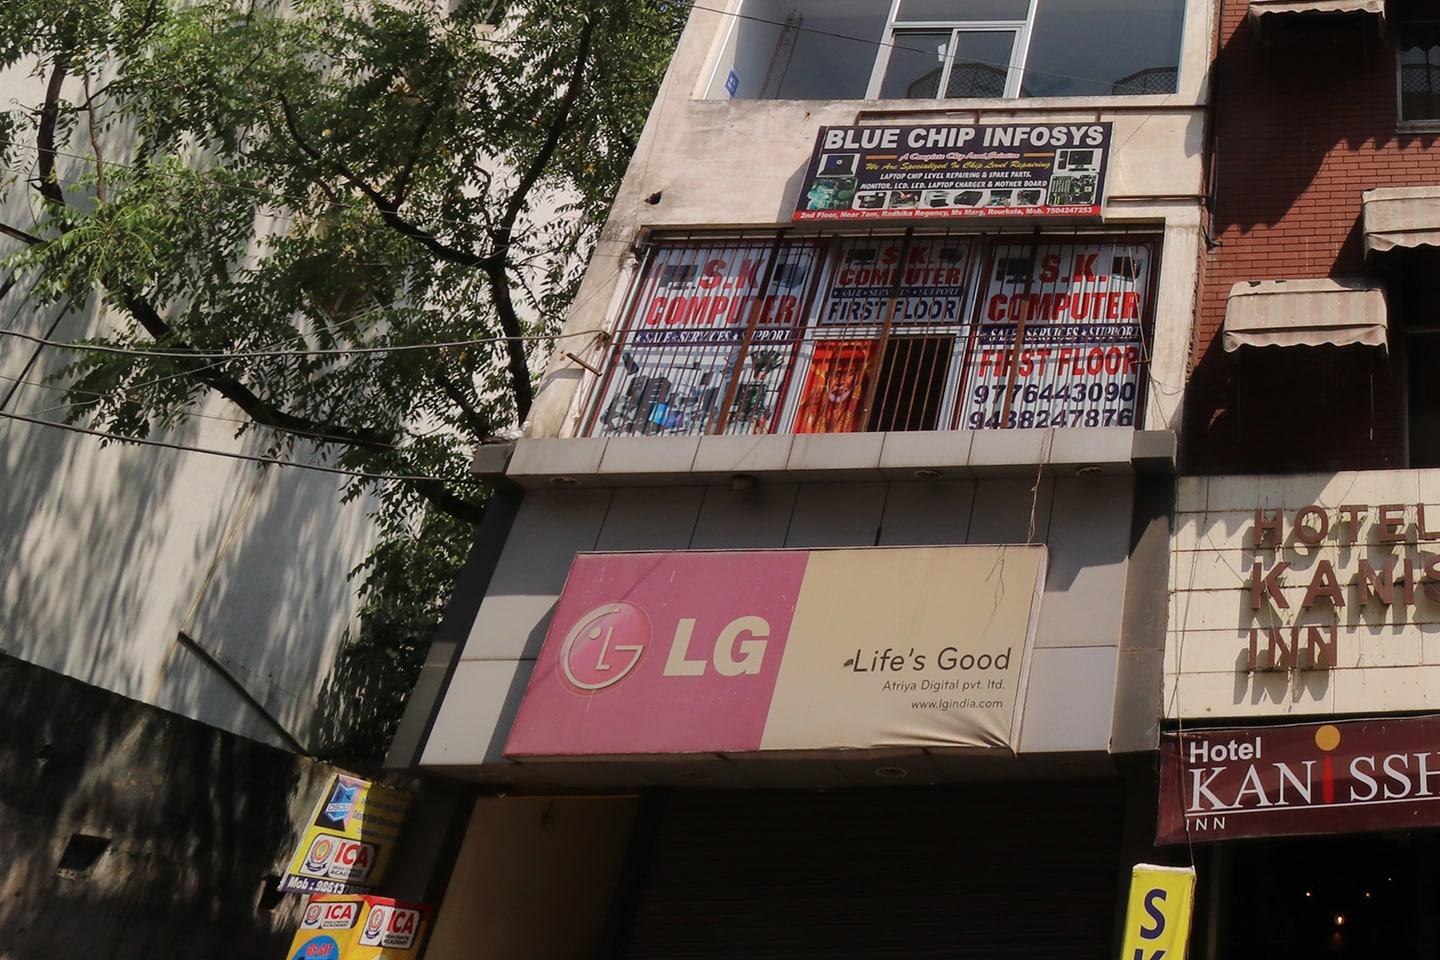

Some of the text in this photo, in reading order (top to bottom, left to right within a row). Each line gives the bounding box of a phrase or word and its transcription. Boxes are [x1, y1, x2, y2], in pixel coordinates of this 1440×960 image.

[824, 125, 1104, 149] BLUE CHIP INFOSYS
[945, 171, 981, 179] REPAIRING
[962, 161, 982, 169] Chip
[1010, 160, 1051, 169] Repairing
[816, 211, 839, 219] Floor,
[881, 210, 912, 218] Radhika
[914, 210, 950, 218] Regency,
[987, 208, 1024, 216] Rourkela,
[1039, 253, 1108, 283] S.K.
[646, 295, 797, 325] COMPUTER
[828, 300, 957, 321] FIRST FLOOR
[987, 292, 1141, 321] COMPUTER
[1026, 326, 1080, 342] SERVICES
[978, 346, 1141, 377] FIRST FLOOR
[974, 382, 1136, 405] 9776443090
[662, 616, 771, 677] LG
[1248, 624, 1338, 670] INN
[853, 646, 1012, 672] Life's Good
[882, 679, 1006, 692] Atriya Digital pvt. ltd.
[911, 698, 1003, 711] www.lgindia.com
[1189, 736, 1262, 763] Hotel
[334, 842, 369, 868] ICA
[287, 877, 308, 890] Mob
[324, 905, 352, 920] ICA
[385, 910, 413, 935] ICA
